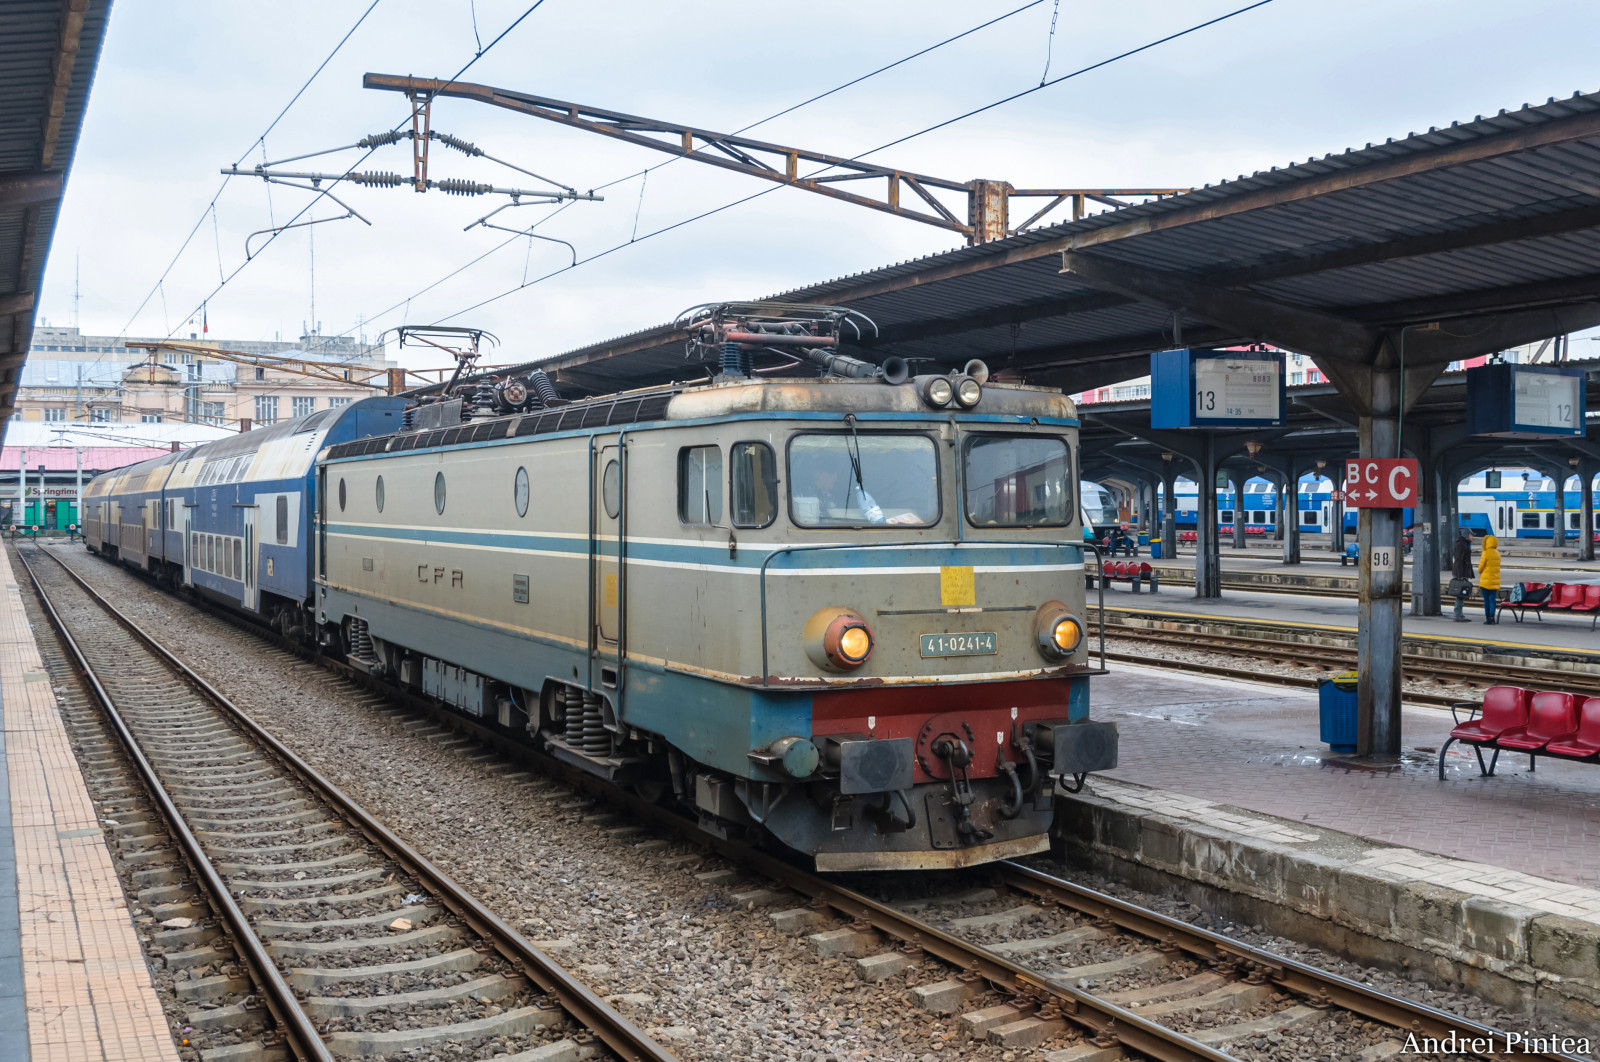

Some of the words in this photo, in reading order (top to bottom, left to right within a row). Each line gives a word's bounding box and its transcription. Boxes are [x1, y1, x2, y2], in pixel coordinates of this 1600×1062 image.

[1197, 390, 1215, 411] 13
[1226, 407, 1242, 415] 14:35
[1557, 404, 1571, 421] 12
[1347, 463, 1360, 484] B
[1365, 462, 1379, 484] C
[1388, 465, 1411, 501] C
[1528, 491, 1534, 500] 2
[1373, 552, 1389, 566] 98
[417, 564, 463, 589] CFR
[928, 636, 992, 652] 41-0241-4
